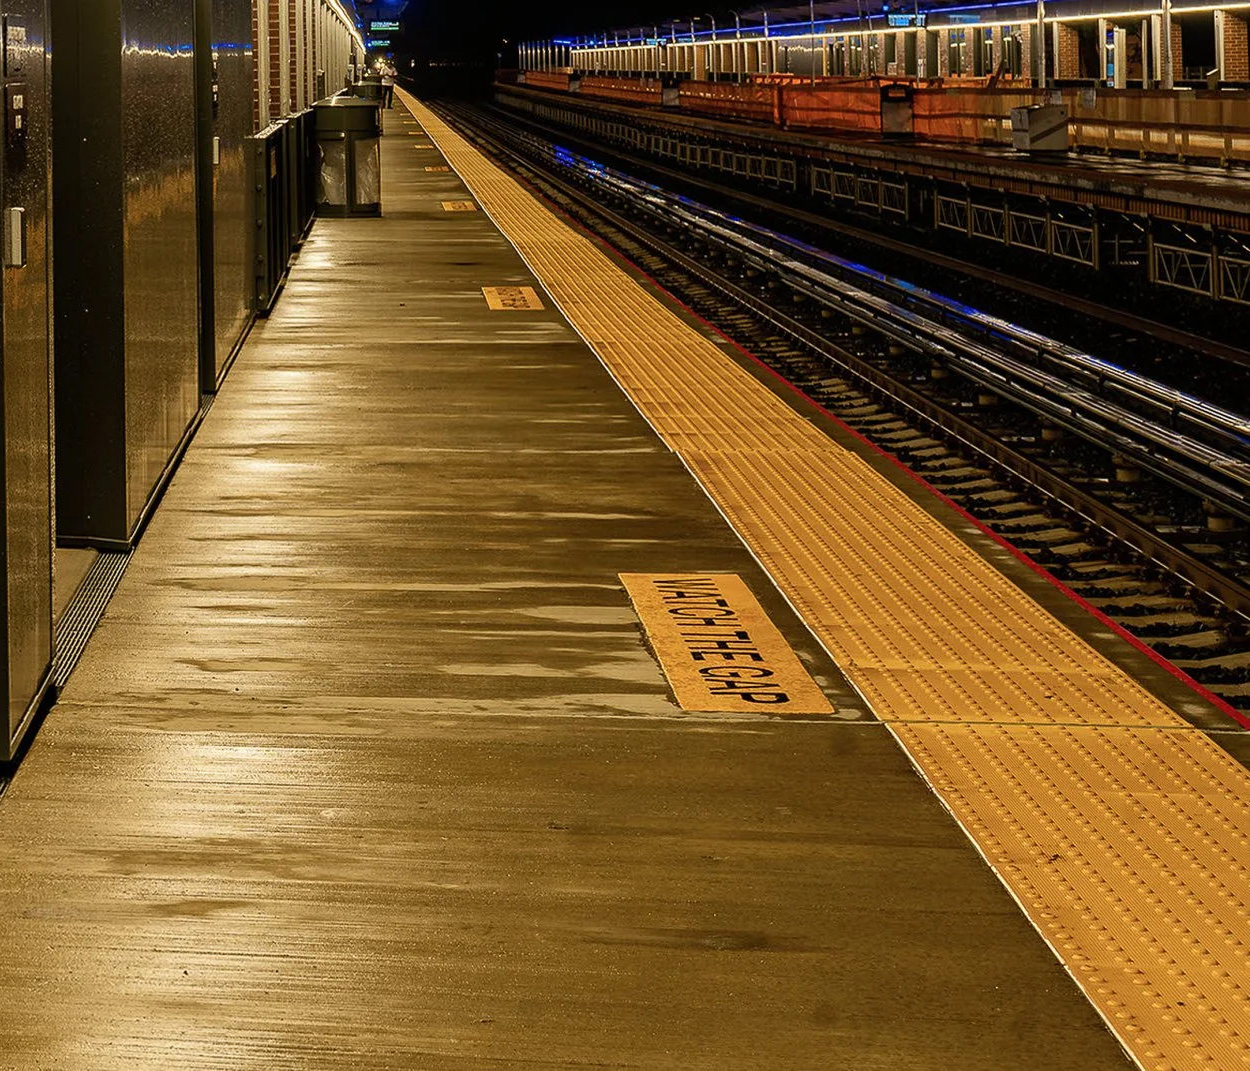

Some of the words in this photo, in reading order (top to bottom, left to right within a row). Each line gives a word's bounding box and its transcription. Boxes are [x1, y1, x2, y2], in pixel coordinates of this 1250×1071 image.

[653, 578, 742, 626] WATCH
[680, 630, 764, 662] THE
[698, 666, 790, 705] GAP
